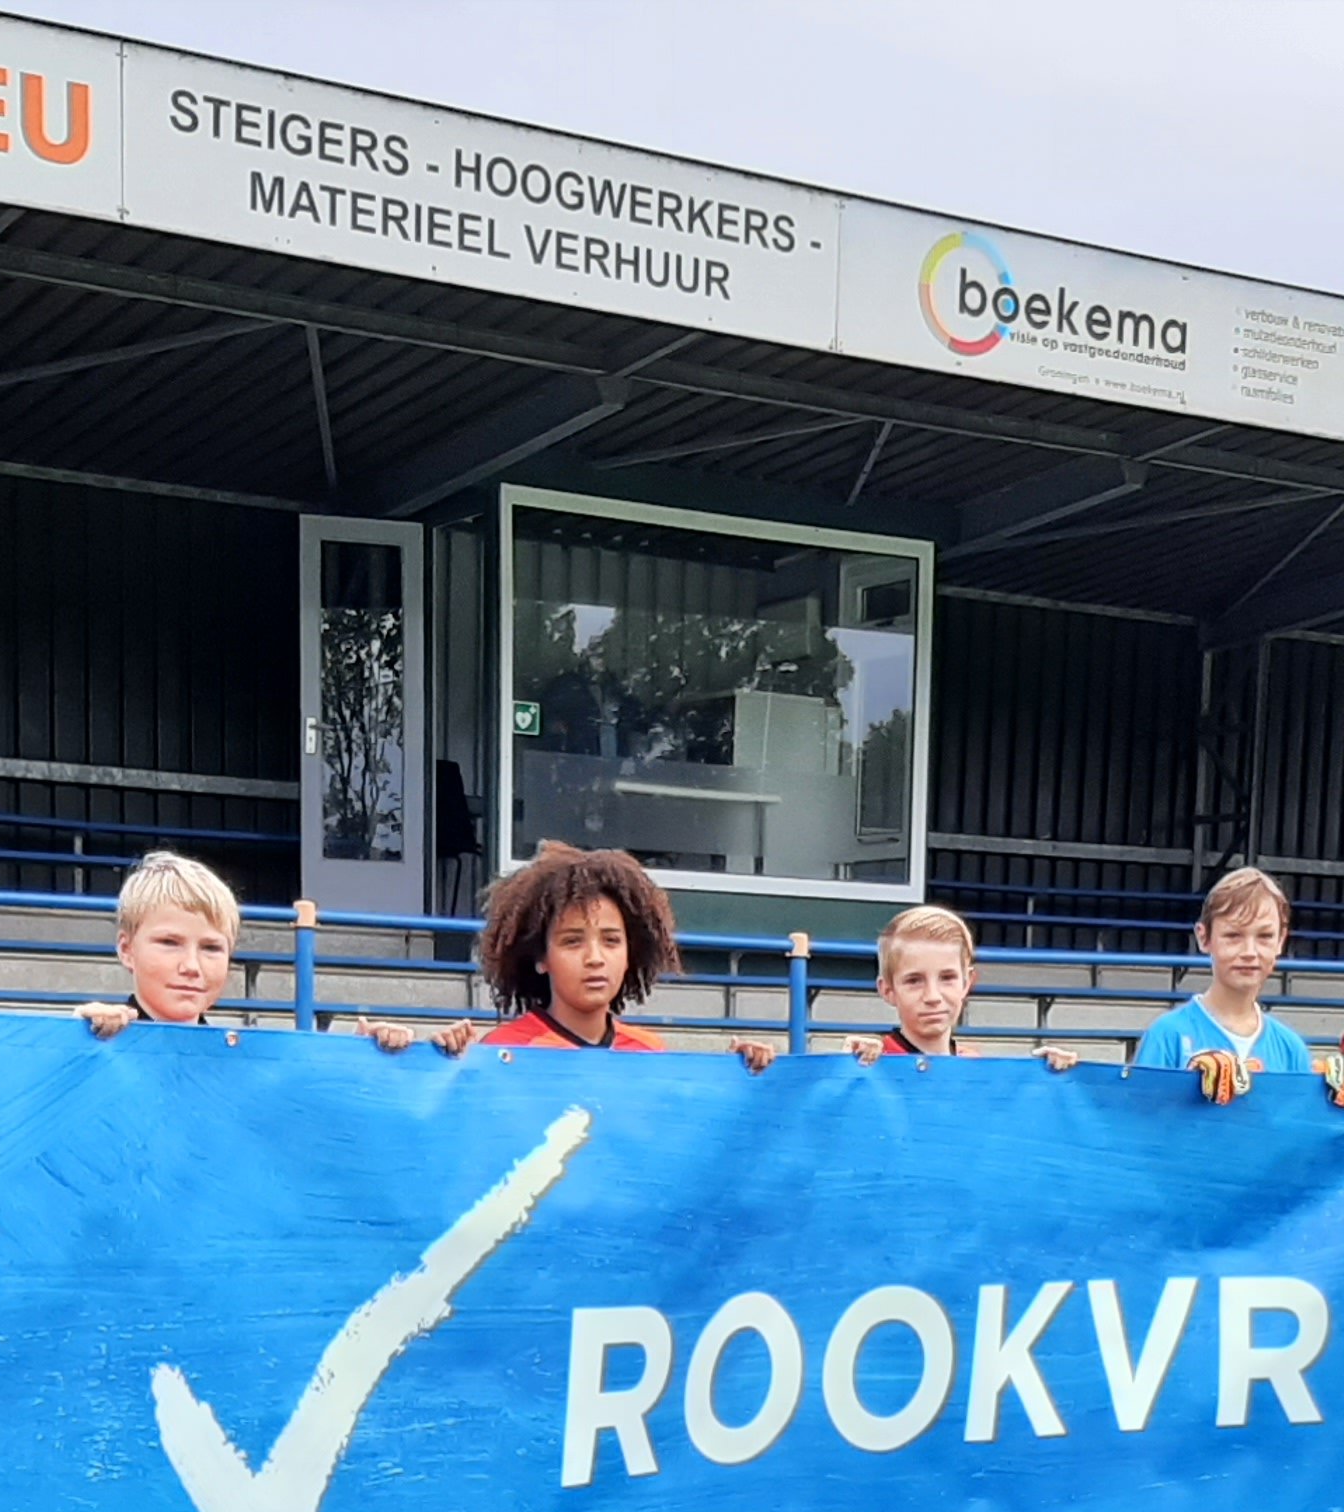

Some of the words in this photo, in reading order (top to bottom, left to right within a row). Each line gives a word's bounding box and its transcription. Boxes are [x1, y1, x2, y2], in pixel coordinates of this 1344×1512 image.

[169, 89, 410, 176] STEIGERS
[454, 148, 796, 253] HOOGWERKERS
[248, 170, 511, 259] MATERIEEL
[523, 224, 731, 300] VERHUUR
[958, 267, 1188, 354] boekema
